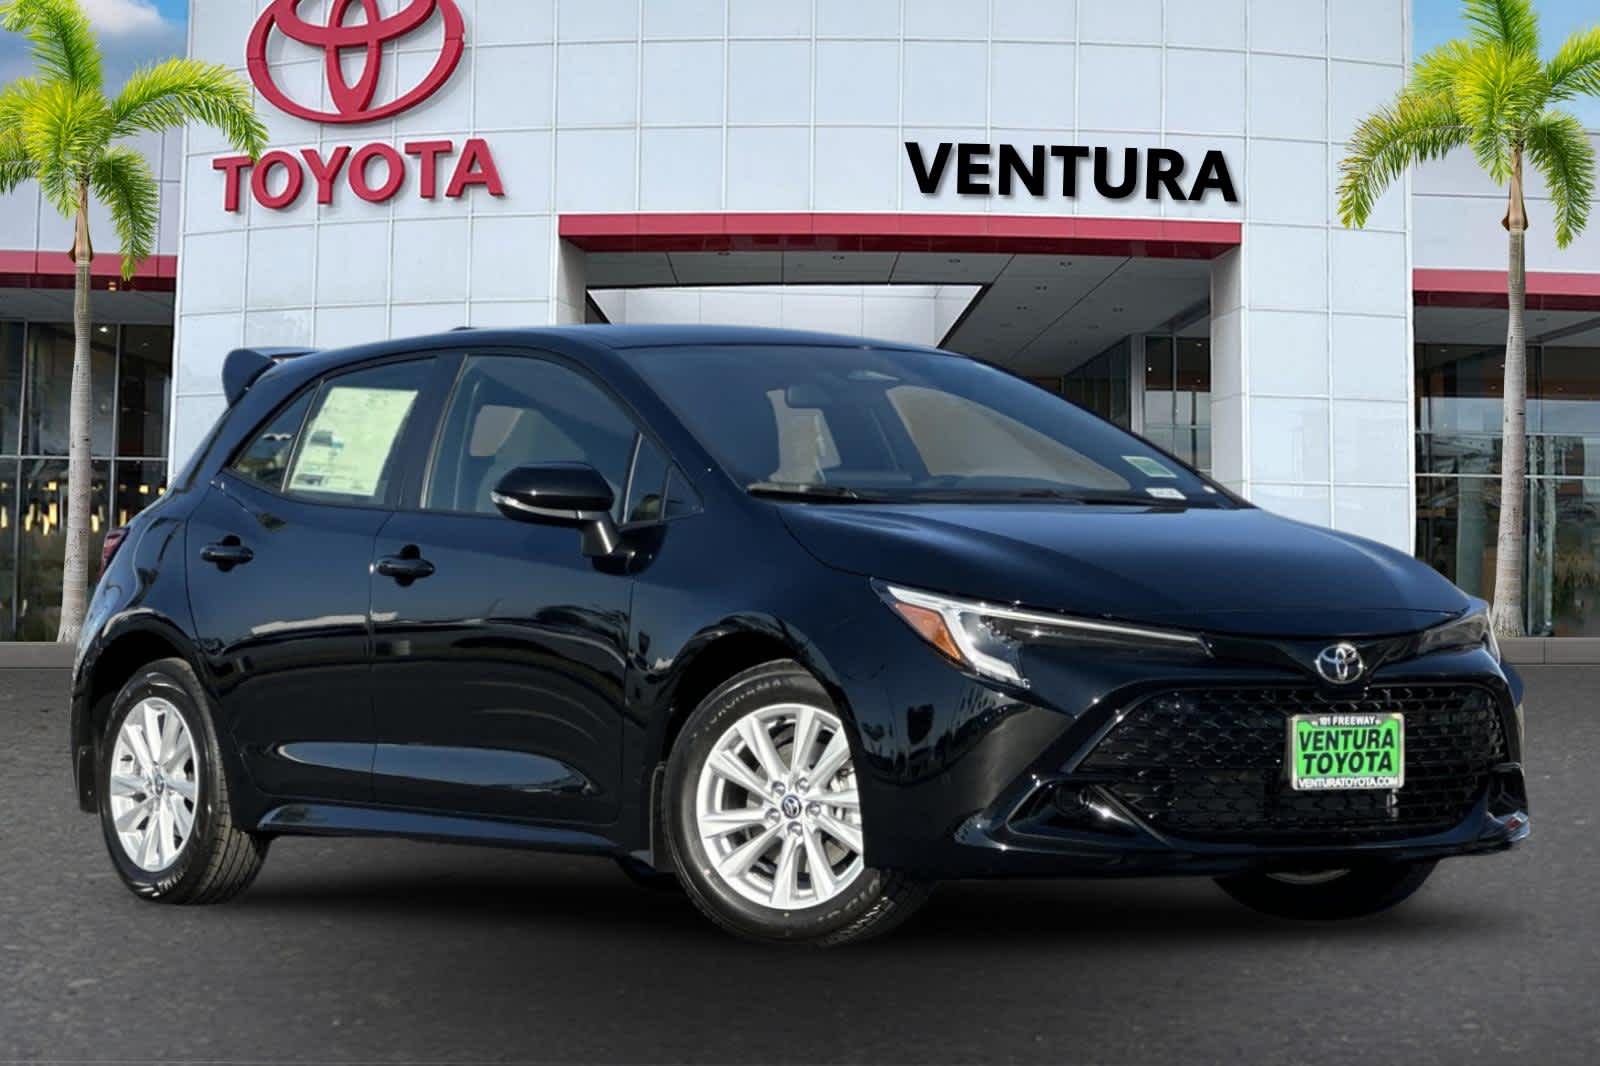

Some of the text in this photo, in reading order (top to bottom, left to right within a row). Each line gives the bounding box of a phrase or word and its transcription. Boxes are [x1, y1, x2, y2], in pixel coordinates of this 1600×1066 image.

[213, 138, 505, 212] TOYOTA
[904, 141, 1239, 203] VENTURA
[1332, 715, 1376, 726] FREEWAY
[1299, 728, 1394, 752] VENTURA
[1303, 751, 1393, 775] TOYOTA
[1298, 776, 1398, 789] VENTURATOYOTA.COM
